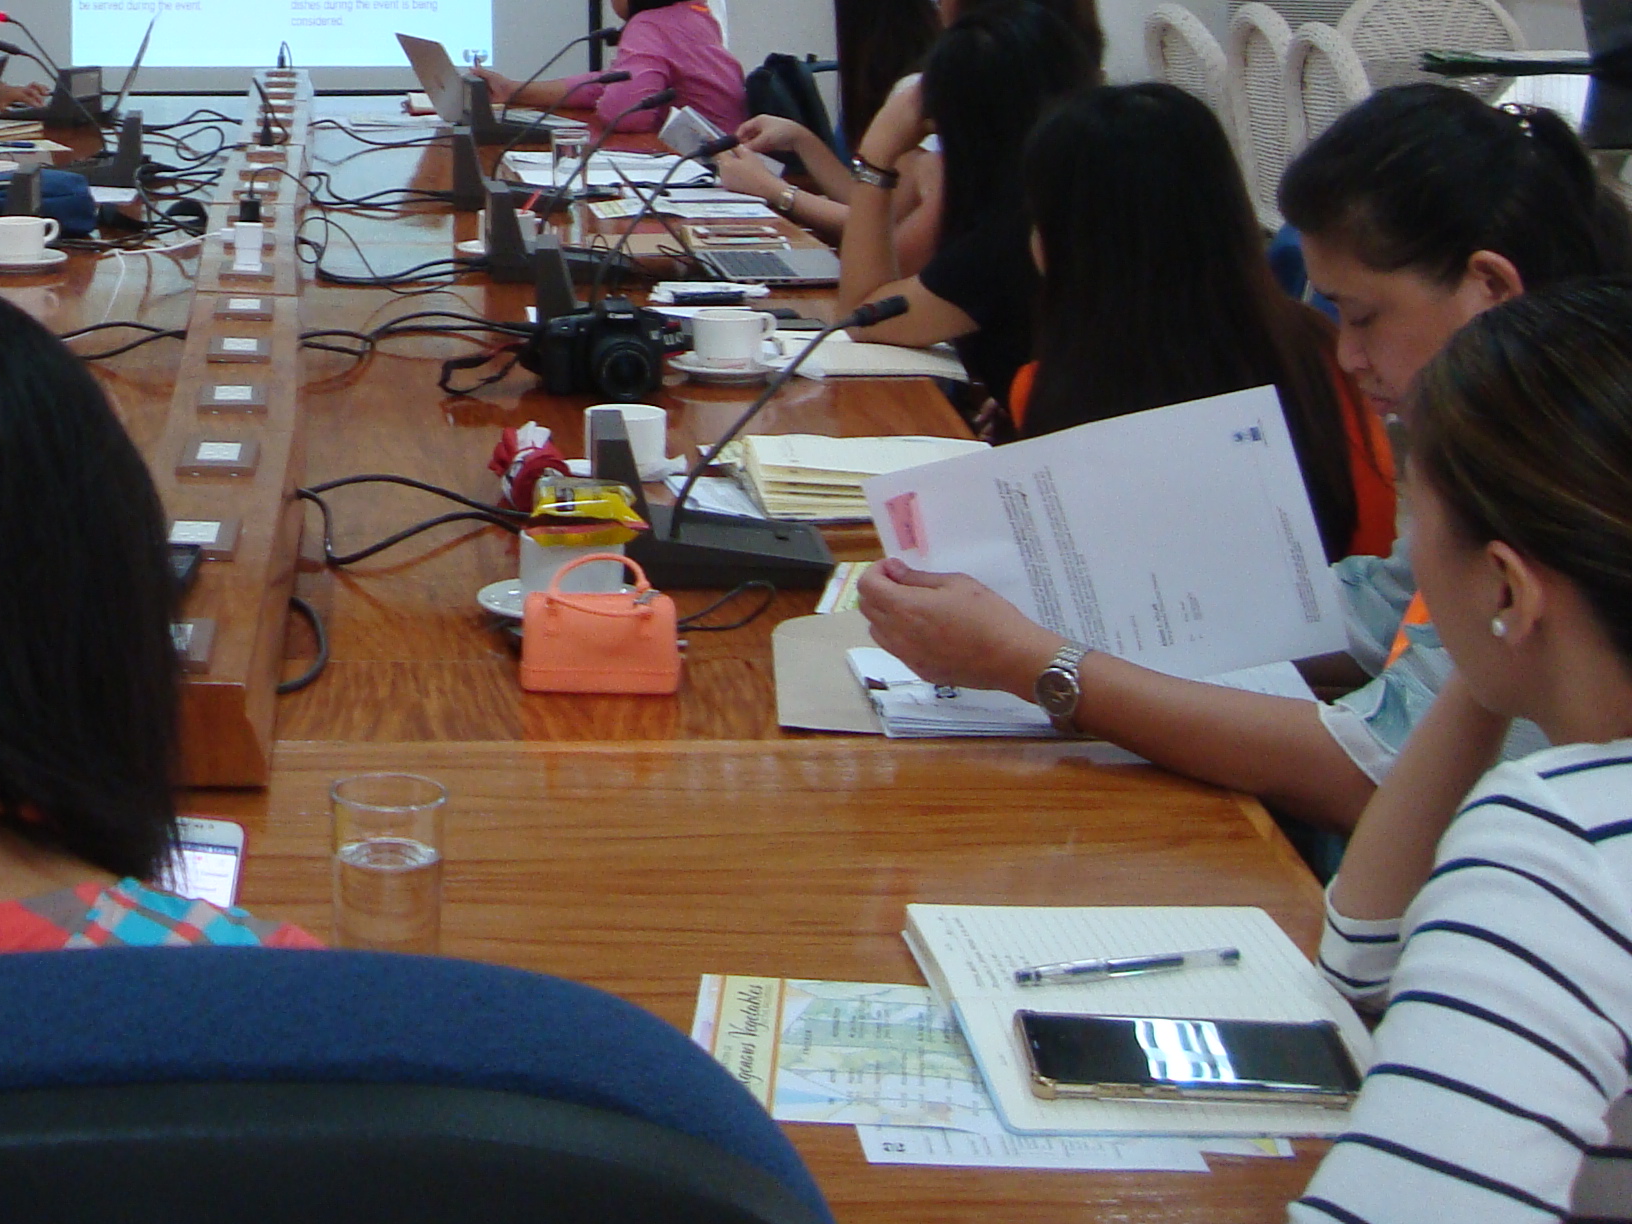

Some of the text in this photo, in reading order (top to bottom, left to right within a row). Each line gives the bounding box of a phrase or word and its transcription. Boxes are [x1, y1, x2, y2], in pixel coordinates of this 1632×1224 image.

[78, 0, 91, 11] be
[92, 0, 124, 11] served
[126, 0, 156, 12] during
[158, 0, 173, 11] the
[291, 0, 438, 12] dishes during the event is being
[727, 984, 769, 1040] Vegetables
